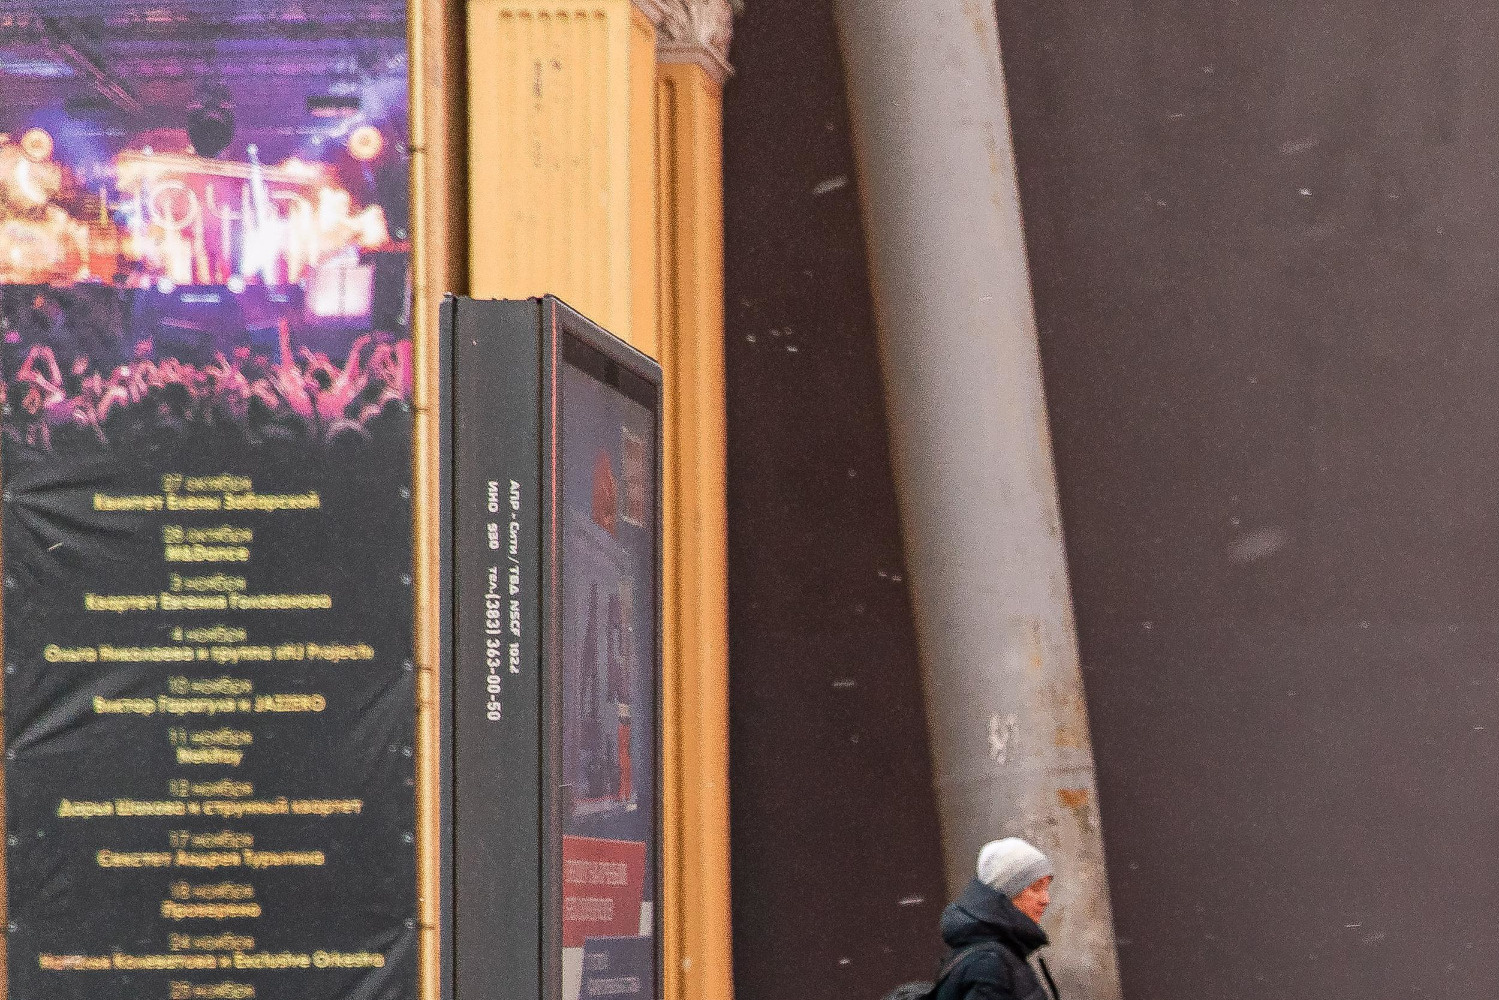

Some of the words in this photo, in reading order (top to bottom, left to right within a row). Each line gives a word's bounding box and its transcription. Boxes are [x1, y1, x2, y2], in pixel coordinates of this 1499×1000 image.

[185, 473, 252, 493] октября
[487, 480, 499, 513] ИНО
[508, 479, 521, 511] АПР
[186, 524, 253, 545] октября
[508, 522, 520, 555] Сити
[184, 573, 247, 592] ноября
[508, 566, 520, 596] ТВД
[508, 599, 521, 637] NSCF
[185, 625, 247, 644] ноября
[192, 676, 253, 696] ноября
[486, 638, 502, 722] 363-00-50
[190, 728, 253, 748] ноября
[192, 779, 253, 799] ноября
[291, 798, 363, 818] квартет
[192, 830, 254, 850] ноября
[193, 881, 254, 901] ноября
[193, 932, 254, 952] ноября
[234, 950, 312, 970] Exclusive
[193, 981, 254, 1000] ноября
